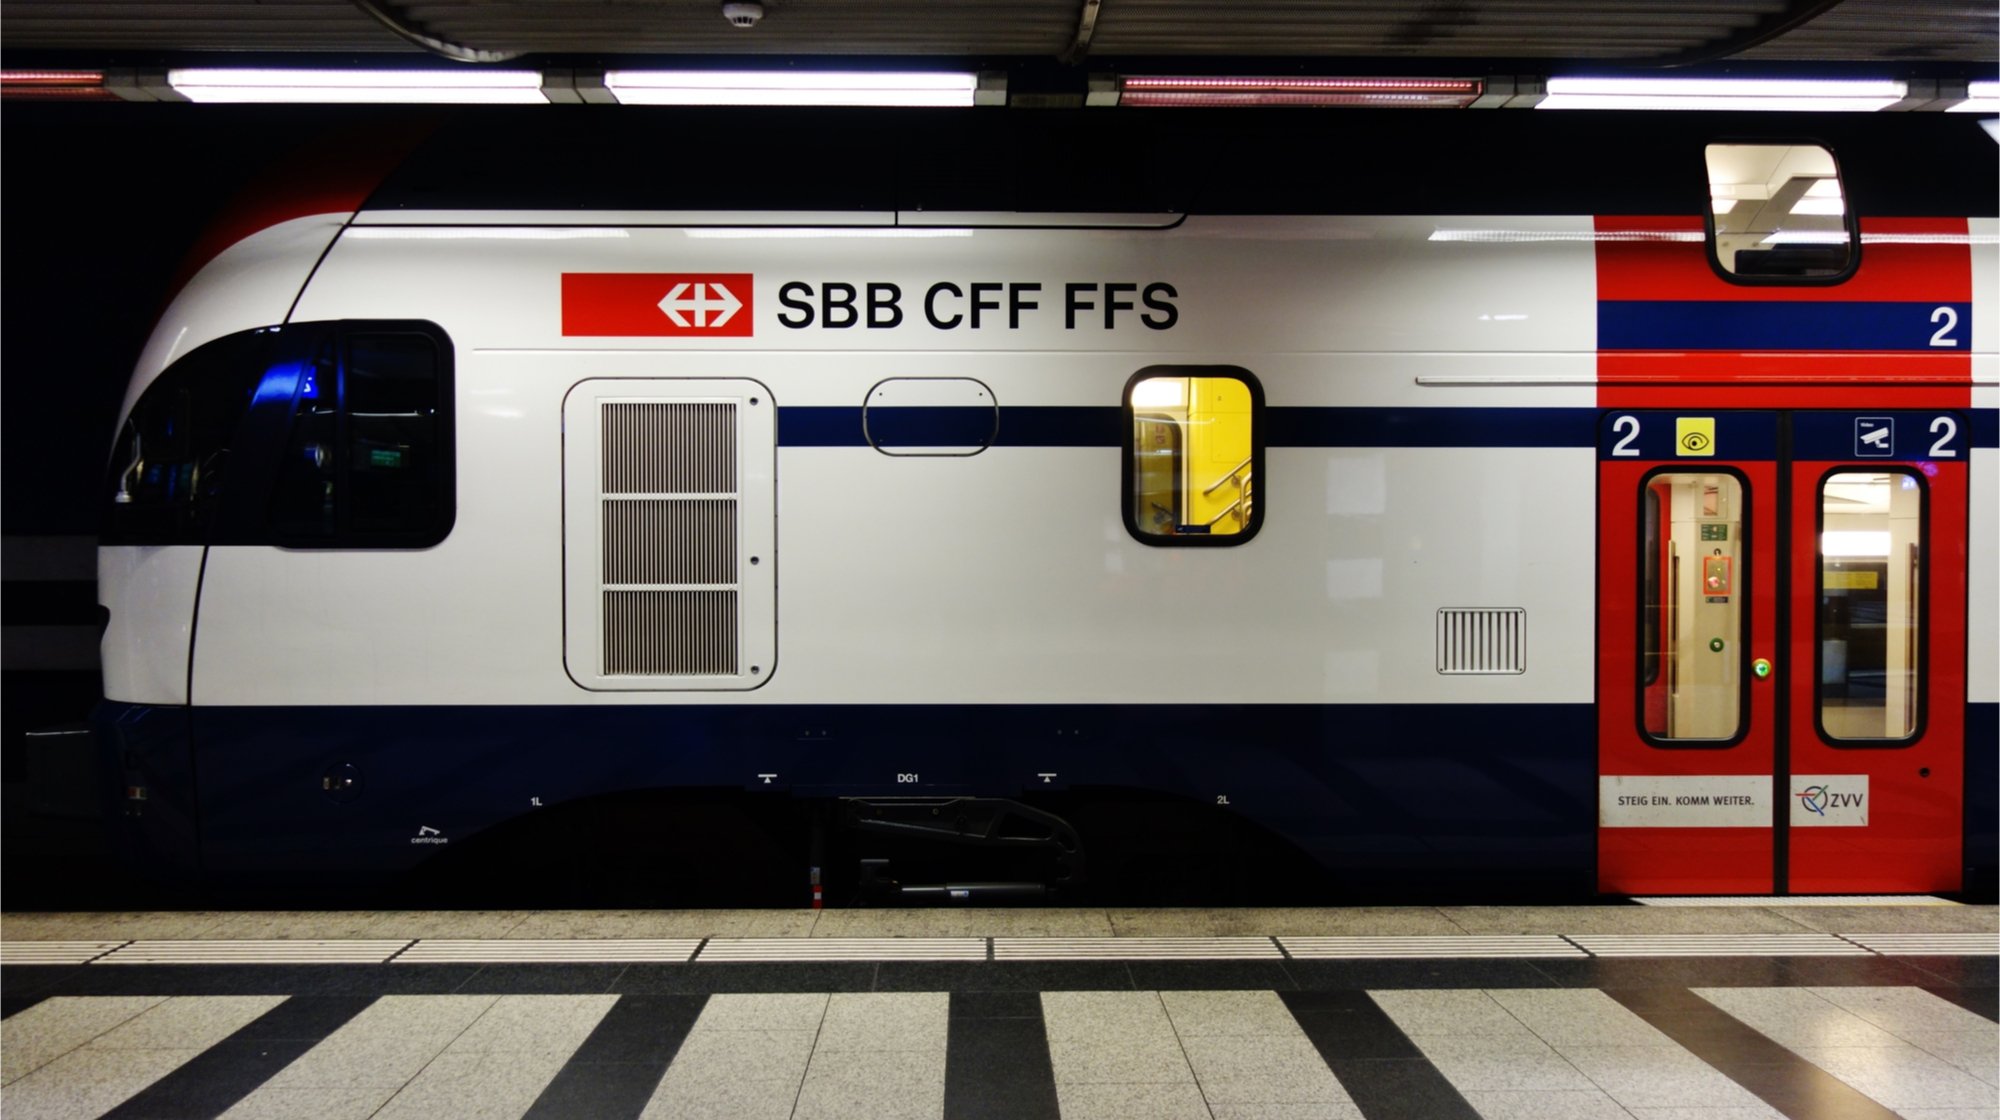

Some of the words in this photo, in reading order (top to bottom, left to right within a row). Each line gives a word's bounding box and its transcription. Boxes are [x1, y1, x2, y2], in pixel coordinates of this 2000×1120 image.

[776, 281, 904, 330] SBB
[923, 281, 1043, 331] CFF
[1064, 281, 1180, 331] FFS
[1929, 306, 1958, 347] 2
[1612, 415, 1641, 457] 2
[1928, 416, 1957, 457] 2
[897, 773, 919, 783] DG1
[530, 796, 543, 806] 1L
[1216, 794, 1231, 805] 2L
[1618, 795, 1649, 806] STEIG
[1651, 795, 1672, 806] EIN.
[1675, 795, 1710, 806] KOMM
[1713, 795, 1755, 806] WEITER.
[1830, 793, 1864, 808] ZVV
[411, 836, 449, 845] centrique
